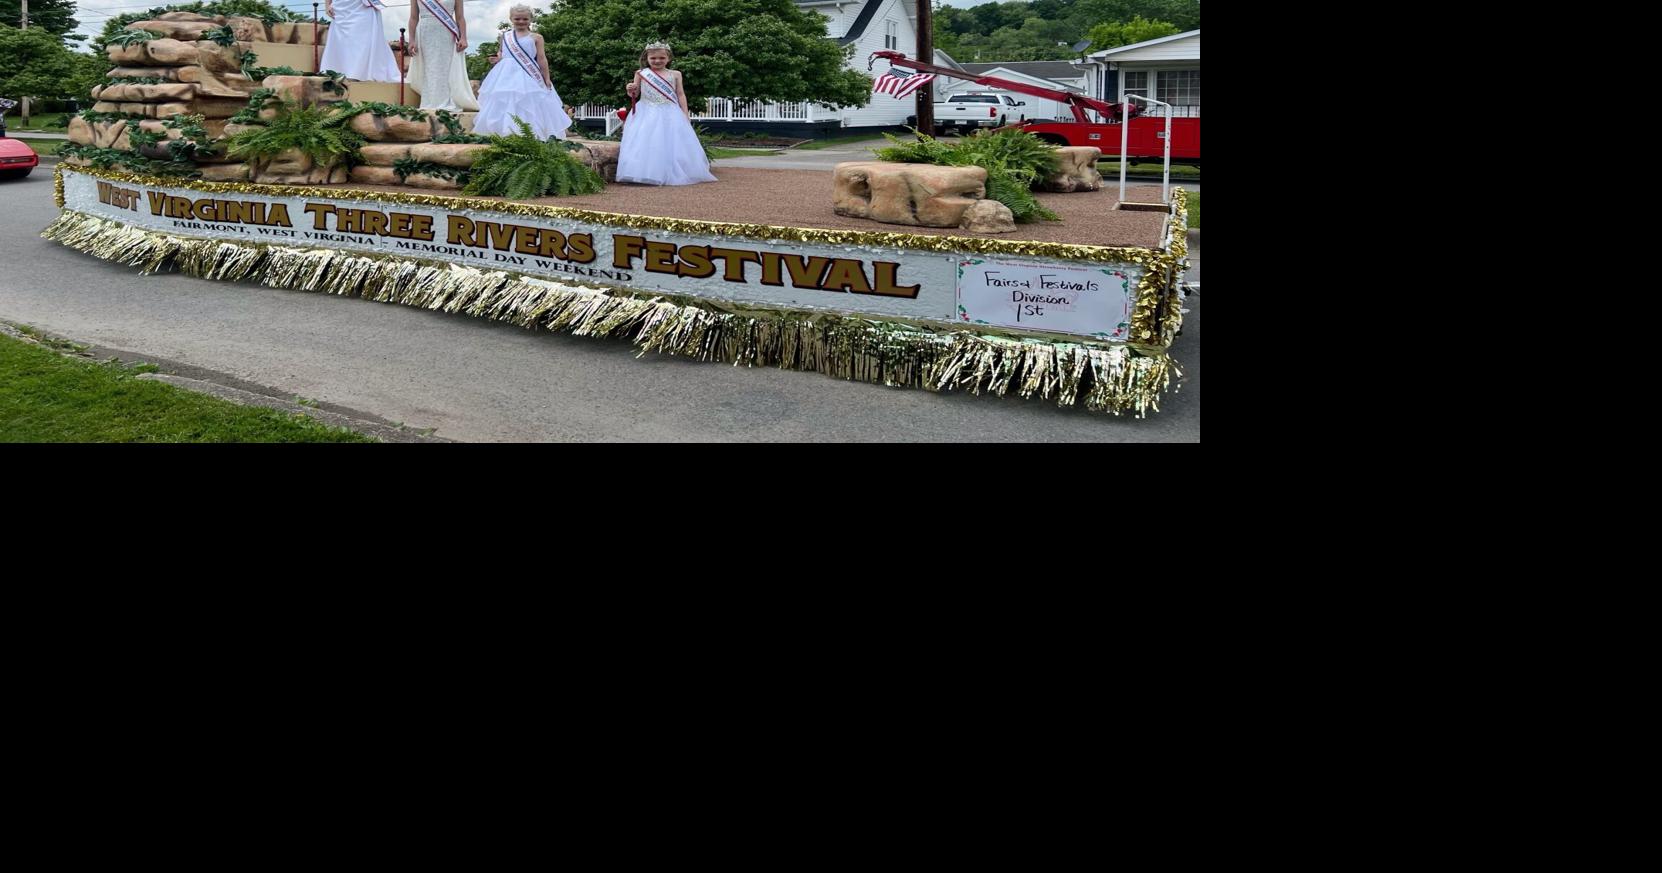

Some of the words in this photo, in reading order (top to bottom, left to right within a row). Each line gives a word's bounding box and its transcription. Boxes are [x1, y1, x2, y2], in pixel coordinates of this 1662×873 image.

[96, 180, 141, 212] WEST
[146, 190, 293, 228] VIRGINIA
[304, 203, 435, 241] THREE
[447, 214, 596, 264] RIVERS
[612, 234, 921, 299] FESTIVAL
[173, 220, 251, 235] FAIRMONT,
[257, 227, 299, 238] WEST
[303, 231, 375, 245] VIRGINIA
[396, 240, 488, 260] MEMORIAL
[494, 253, 527, 266] DAY
[535, 259, 632, 282] WEEKEND
[1012, 290, 1070, 305] Division
[1040, 274, 1099, 292] Festivals
